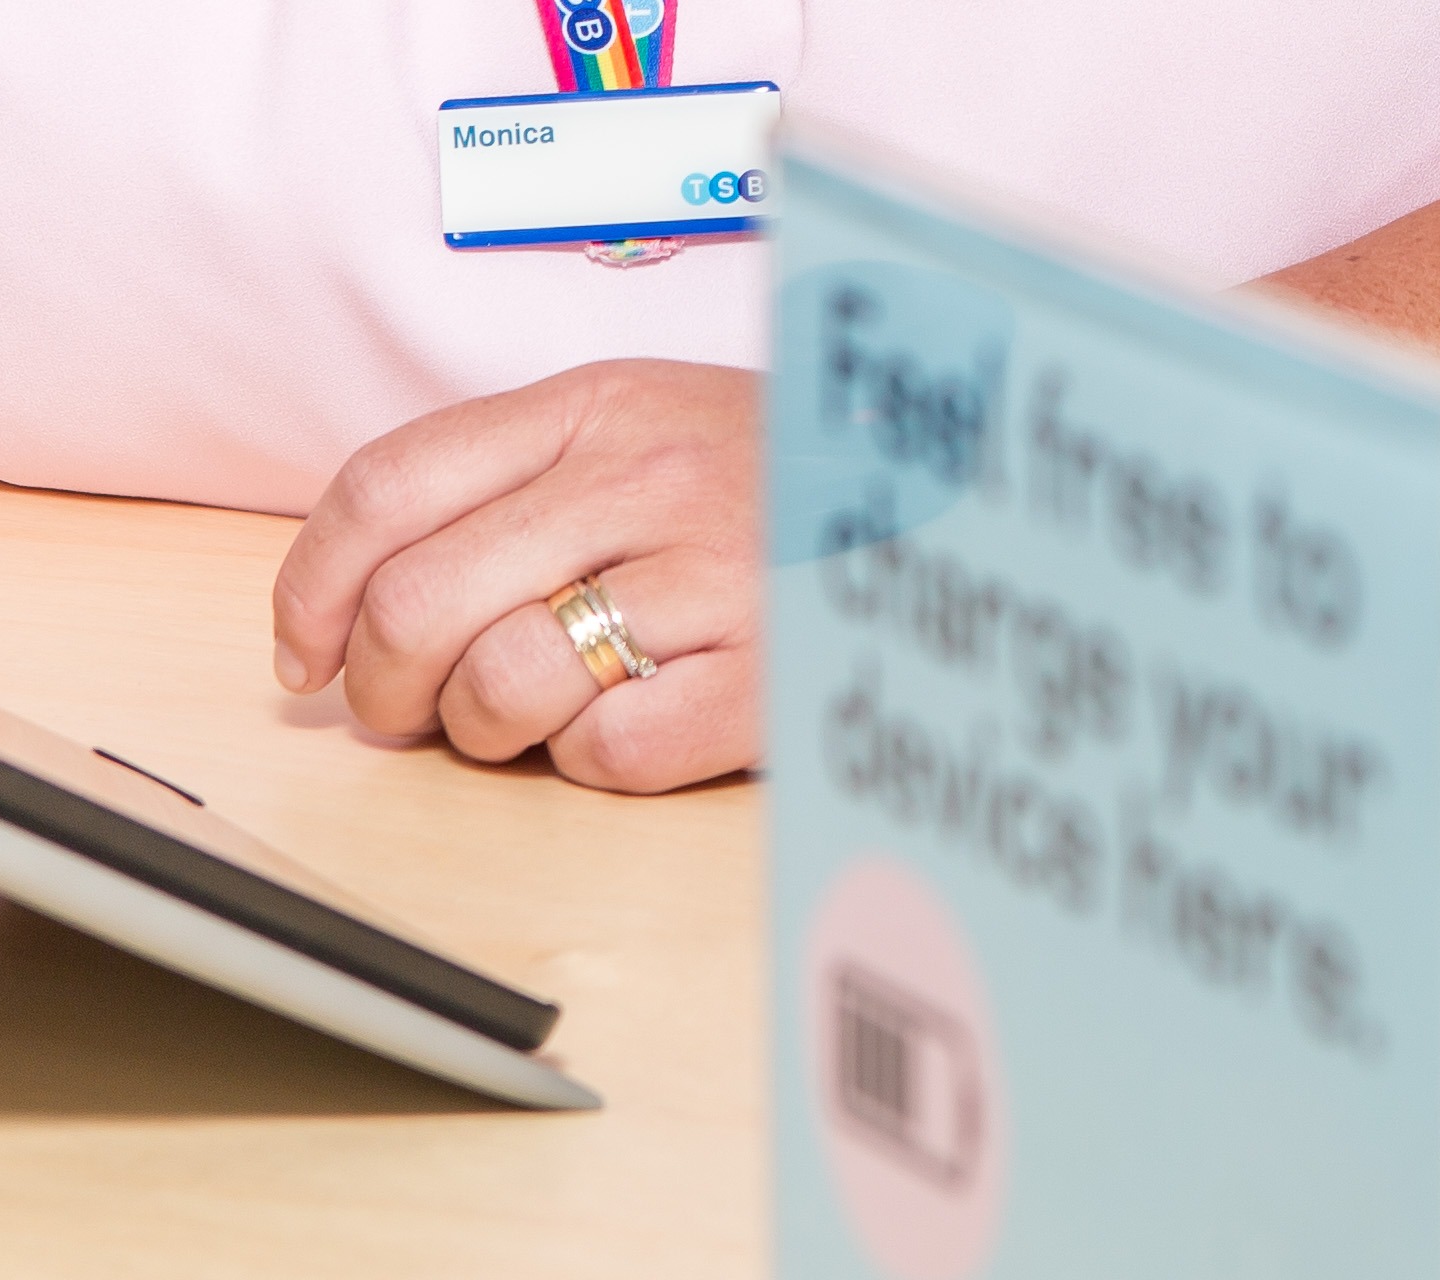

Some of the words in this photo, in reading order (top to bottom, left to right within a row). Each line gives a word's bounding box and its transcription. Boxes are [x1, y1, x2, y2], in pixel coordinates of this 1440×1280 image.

[452, 122, 556, 149] Monica
[685, 172, 767, 203] TSB
[820, 282, 1006, 497] Feel
[1026, 362, 1230, 597] free
[1250, 470, 1365, 653] to
[817, 474, 1133, 760] charge
[1147, 655, 1387, 843] your
[820, 650, 1105, 919] device
[1118, 780, 1386, 1058] here.
